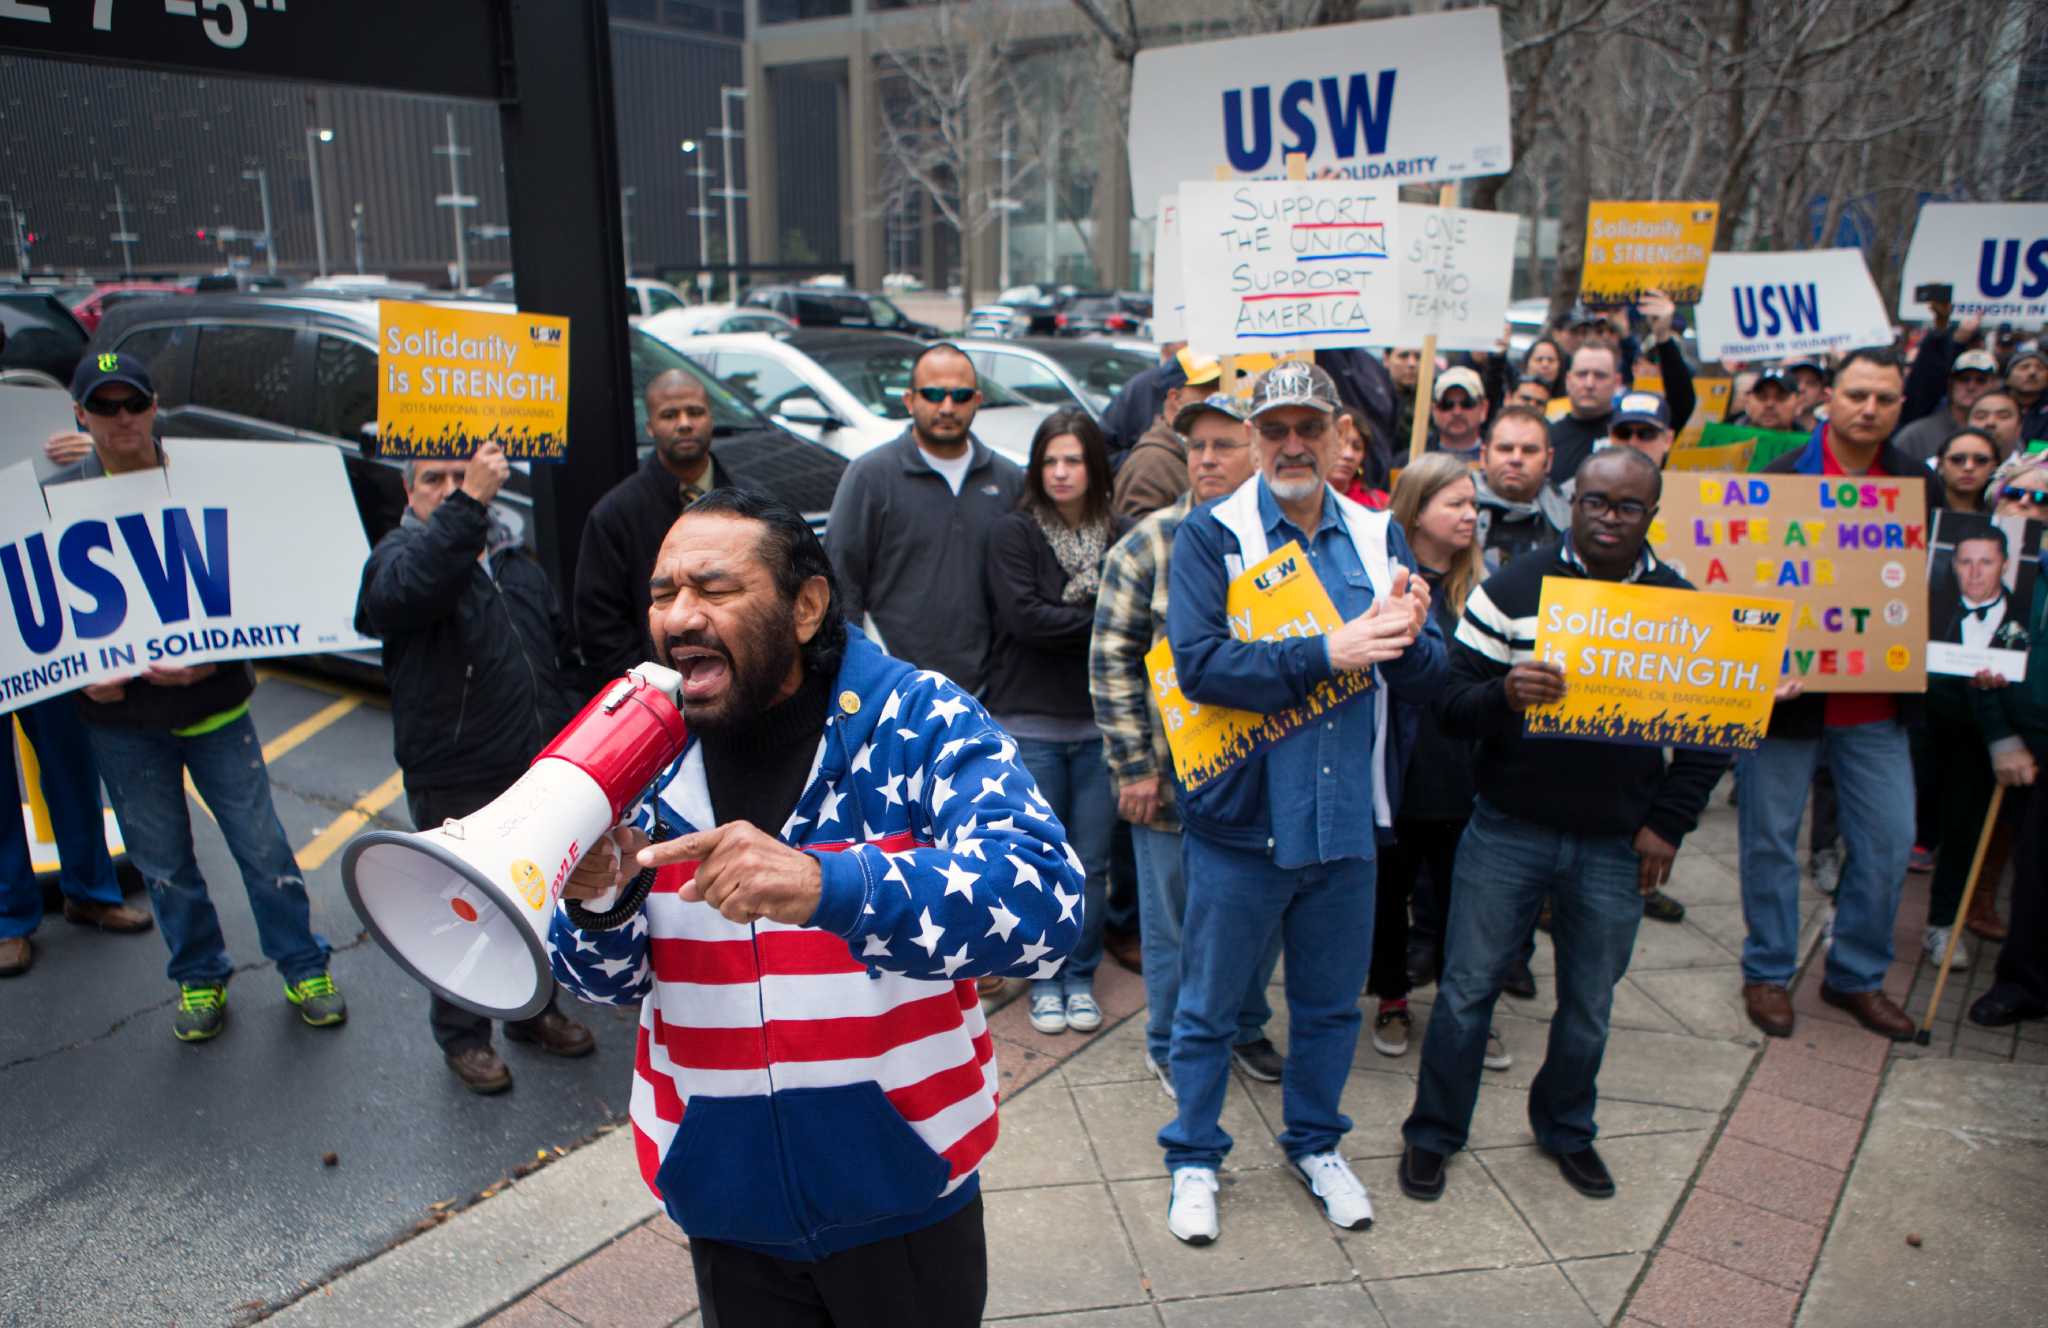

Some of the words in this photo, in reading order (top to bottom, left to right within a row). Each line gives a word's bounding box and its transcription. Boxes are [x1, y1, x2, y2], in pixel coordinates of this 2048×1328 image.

[1222, 68, 1397, 173] USW
[1232, 187, 1376, 225] SUPPORT
[1221, 227, 1271, 252] THE
[1290, 227, 1387, 253] UNION
[1424, 212, 1468, 244] ONE
[1232, 263, 1372, 292] SUPPORT
[1424, 268, 1469, 294] TWO
[1235, 301, 1368, 331] AMERICA
[1407, 293, 1468, 321] TEAMS
[1732, 283, 1820, 339] USW
[387, 325, 518, 369] Solidarity
[388, 363, 410, 394] is
[421, 366, 561, 404] STRENGTH.
[1700, 480, 1770, 506] DAD
[1820, 482, 1899, 512] LOST
[1694, 518, 1770, 546] LIFE
[1784, 521, 1825, 546] AT
[1838, 523, 1926, 550] WORK
[0, 507, 231, 655] USW
[1253, 557, 1297, 591] USW
[1706, 558, 1729, 584] A
[1755, 560, 1835, 587] FAIR
[1546, 604, 1712, 653] Solidarity
[1732, 608, 1781, 626] USW
[99, 644, 136, 669] IN
[146, 623, 300, 661] SOLIDARITY
[1578, 647, 1767, 693] STRENGTH.
[1583, 682, 1643, 699] NATIONAL
[1673, 693, 1752, 711] BARGAINING
[1167, 707, 1184, 731] is
